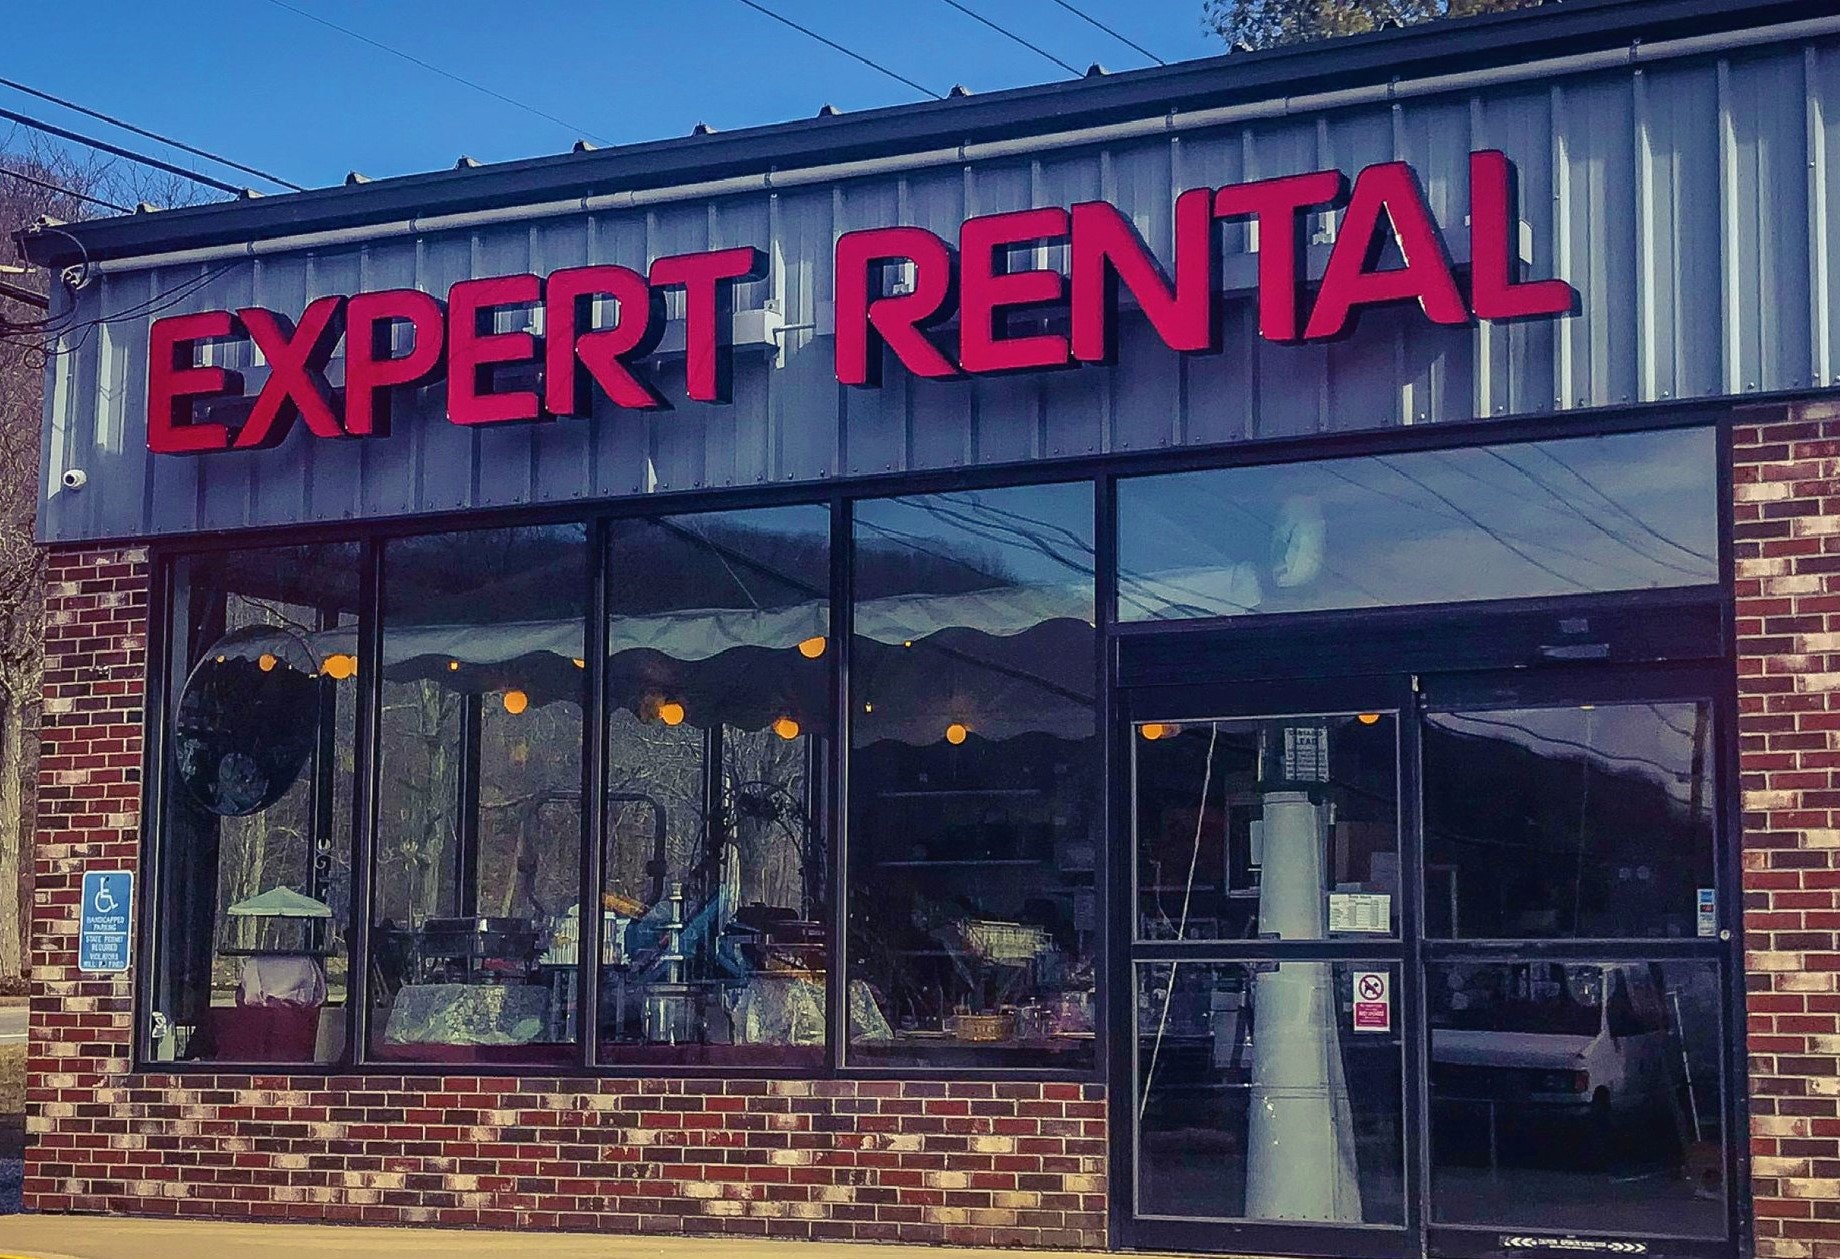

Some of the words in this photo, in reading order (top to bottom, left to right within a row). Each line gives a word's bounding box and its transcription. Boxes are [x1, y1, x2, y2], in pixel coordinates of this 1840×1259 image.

[147, 246, 760, 454] EXPERT
[834, 150, 1577, 386] RENTAL
[86, 916, 125, 924] HANDICAPPED
[91, 943, 118, 952] REQUIRED
